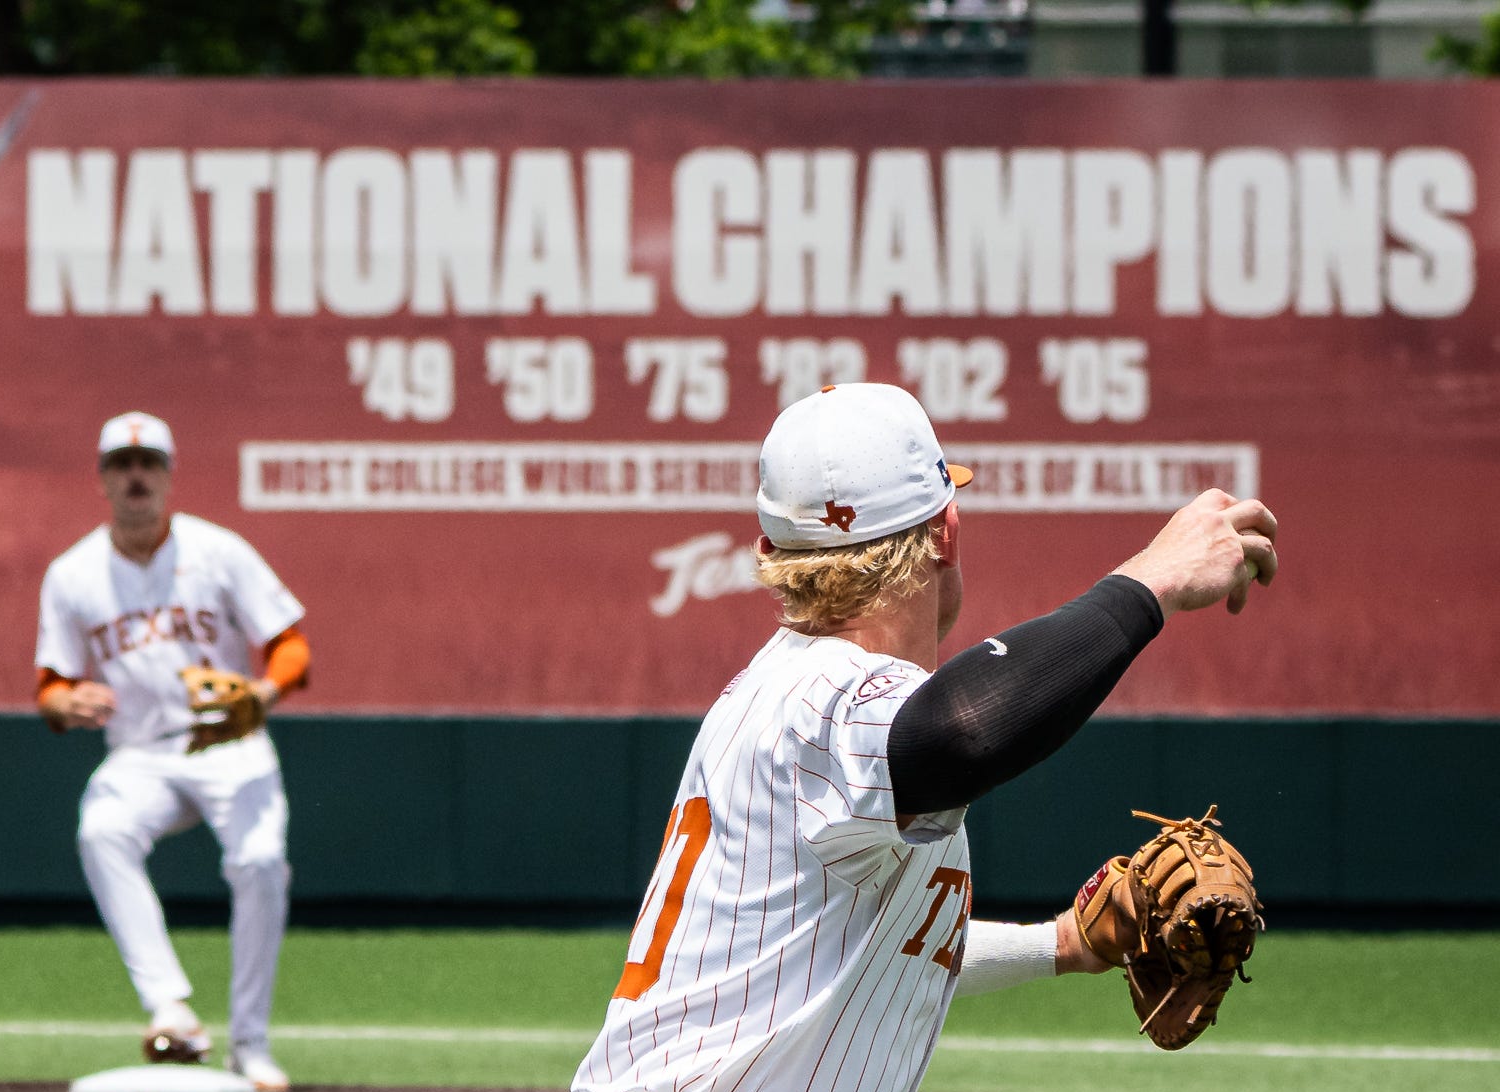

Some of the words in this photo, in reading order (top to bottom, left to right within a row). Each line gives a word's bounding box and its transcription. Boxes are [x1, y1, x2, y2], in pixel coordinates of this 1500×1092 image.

[27, 149, 655, 316] NATIONAL
[672, 147, 1475, 318] CHAMPIONS
[347, 337, 454, 422] '49
[486, 337, 593, 422] '50
[625, 337, 729, 422] '75
[898, 337, 1008, 422] '02
[1039, 338, 1148, 423] '05
[260, 459, 350, 493] MOST
[366, 459, 505, 493] COLLEGE
[521, 459, 638, 493] WORLD
[88, 606, 218, 660] TEXAS
